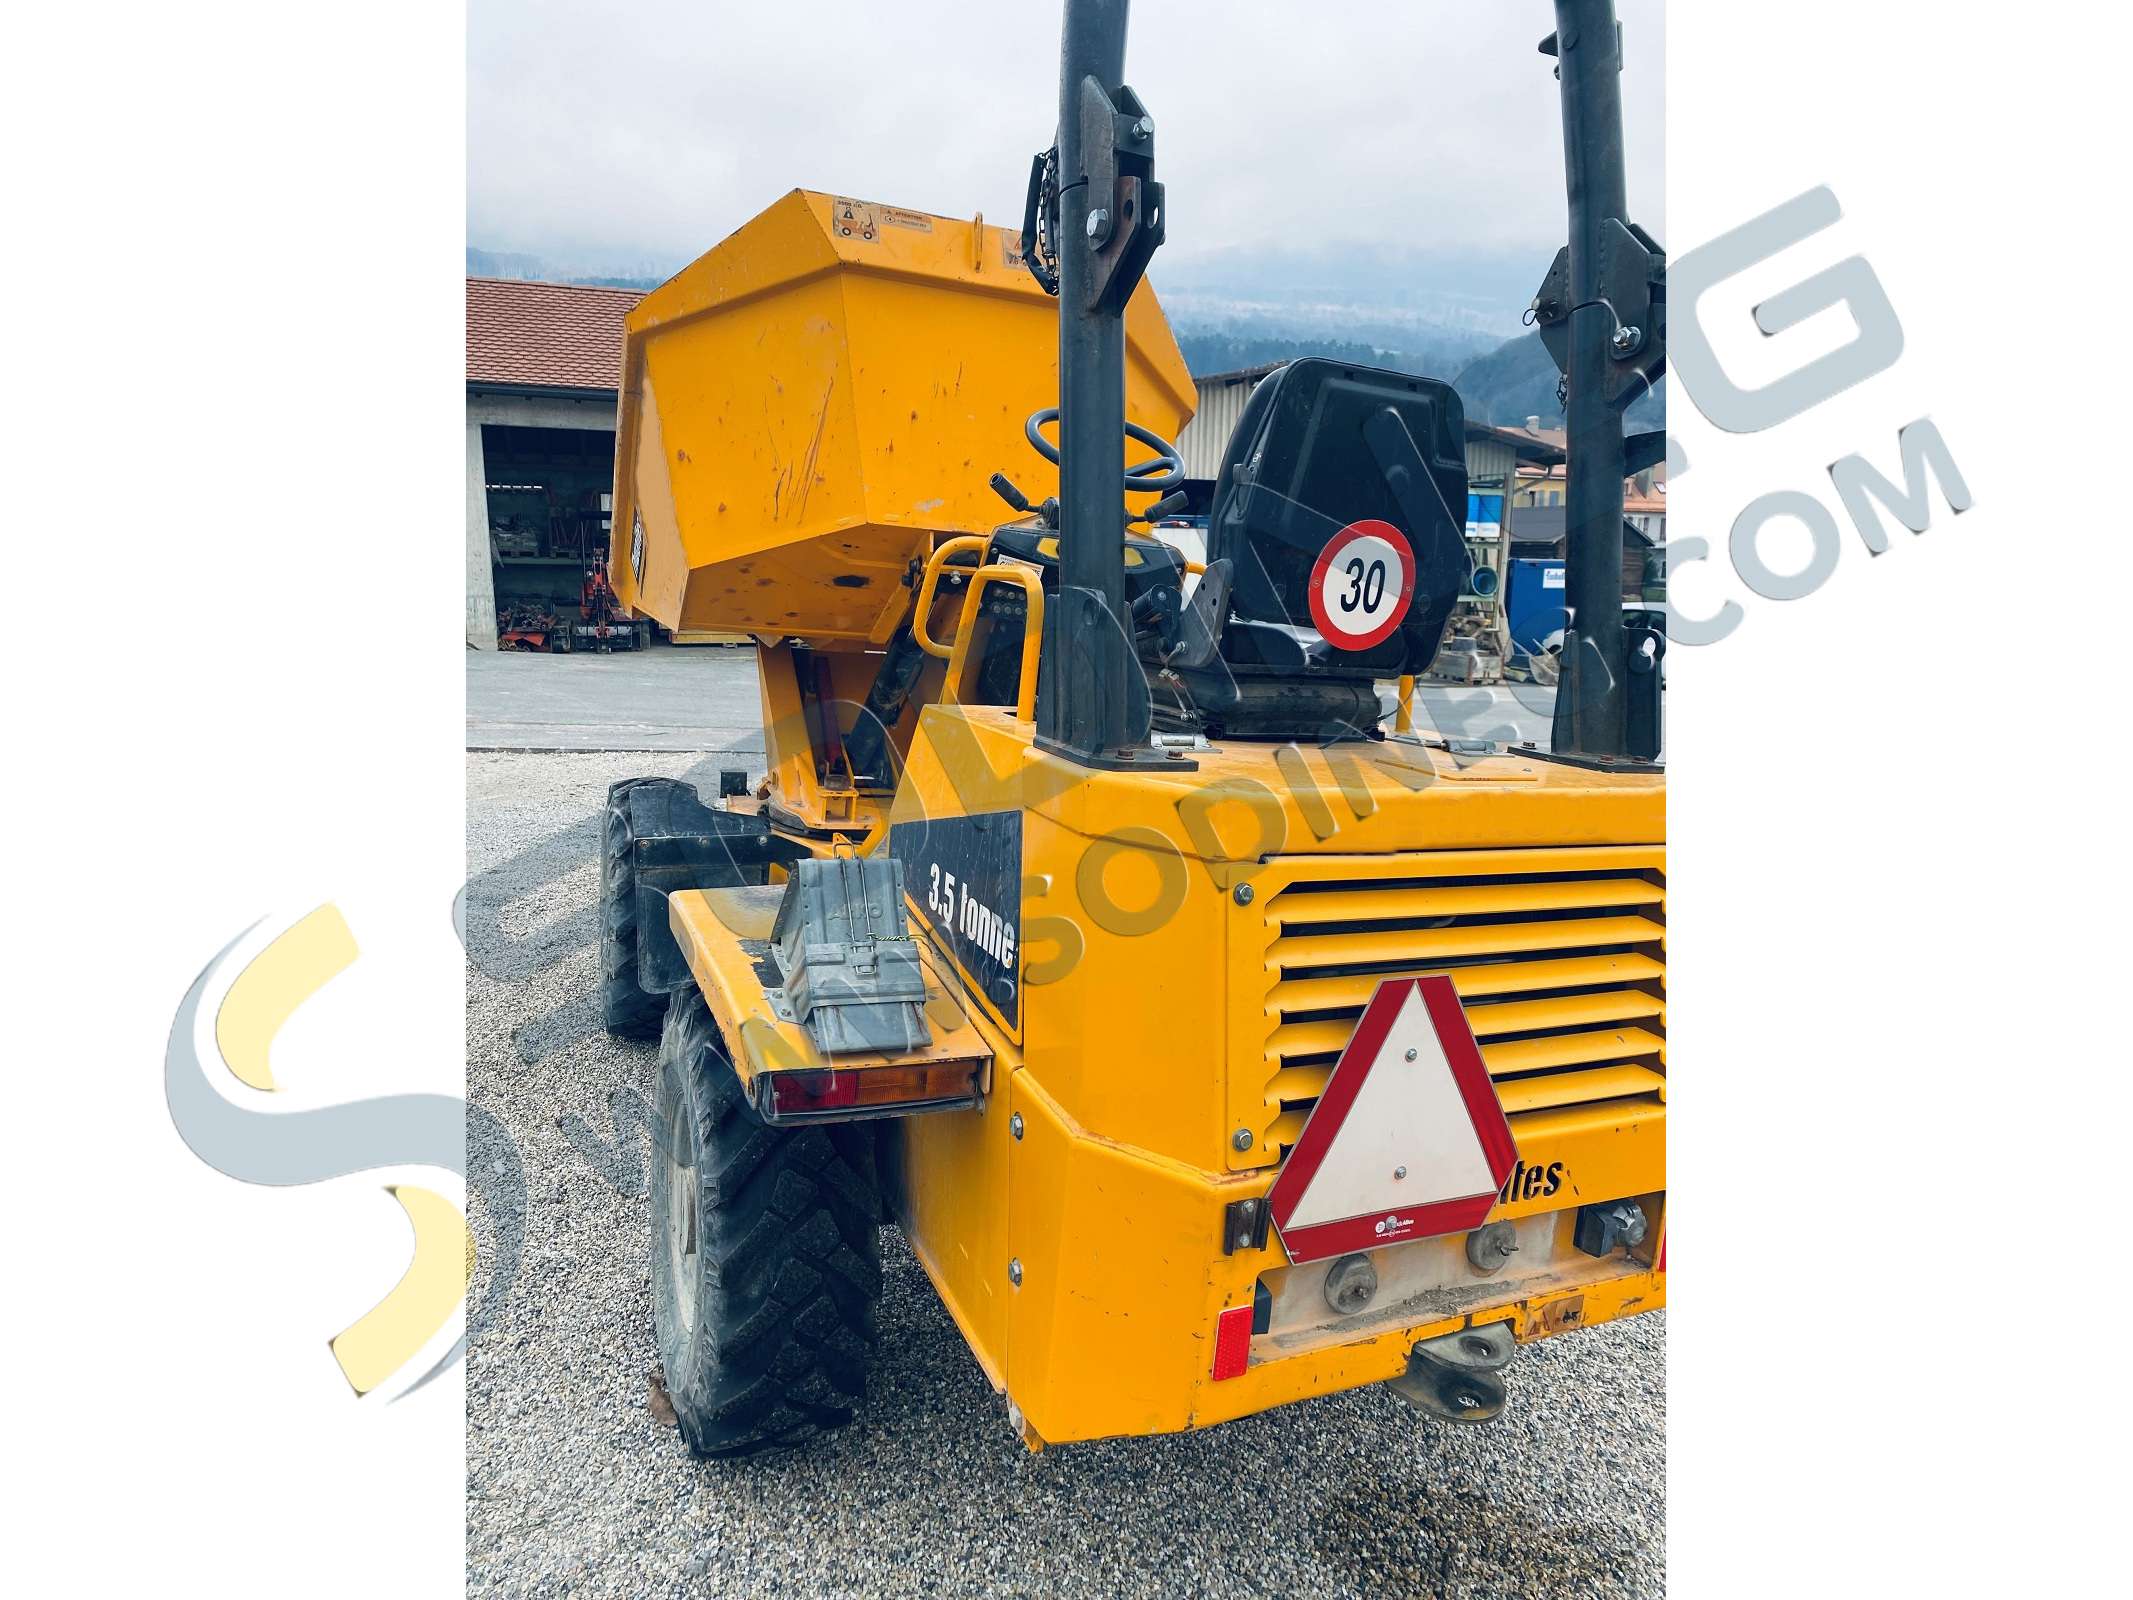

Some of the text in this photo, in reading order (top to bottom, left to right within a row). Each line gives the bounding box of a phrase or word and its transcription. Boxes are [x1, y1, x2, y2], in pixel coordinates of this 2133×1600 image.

[1340, 557, 1386, 614] 30
[928, 863, 1016, 969] 3.5 tonne
